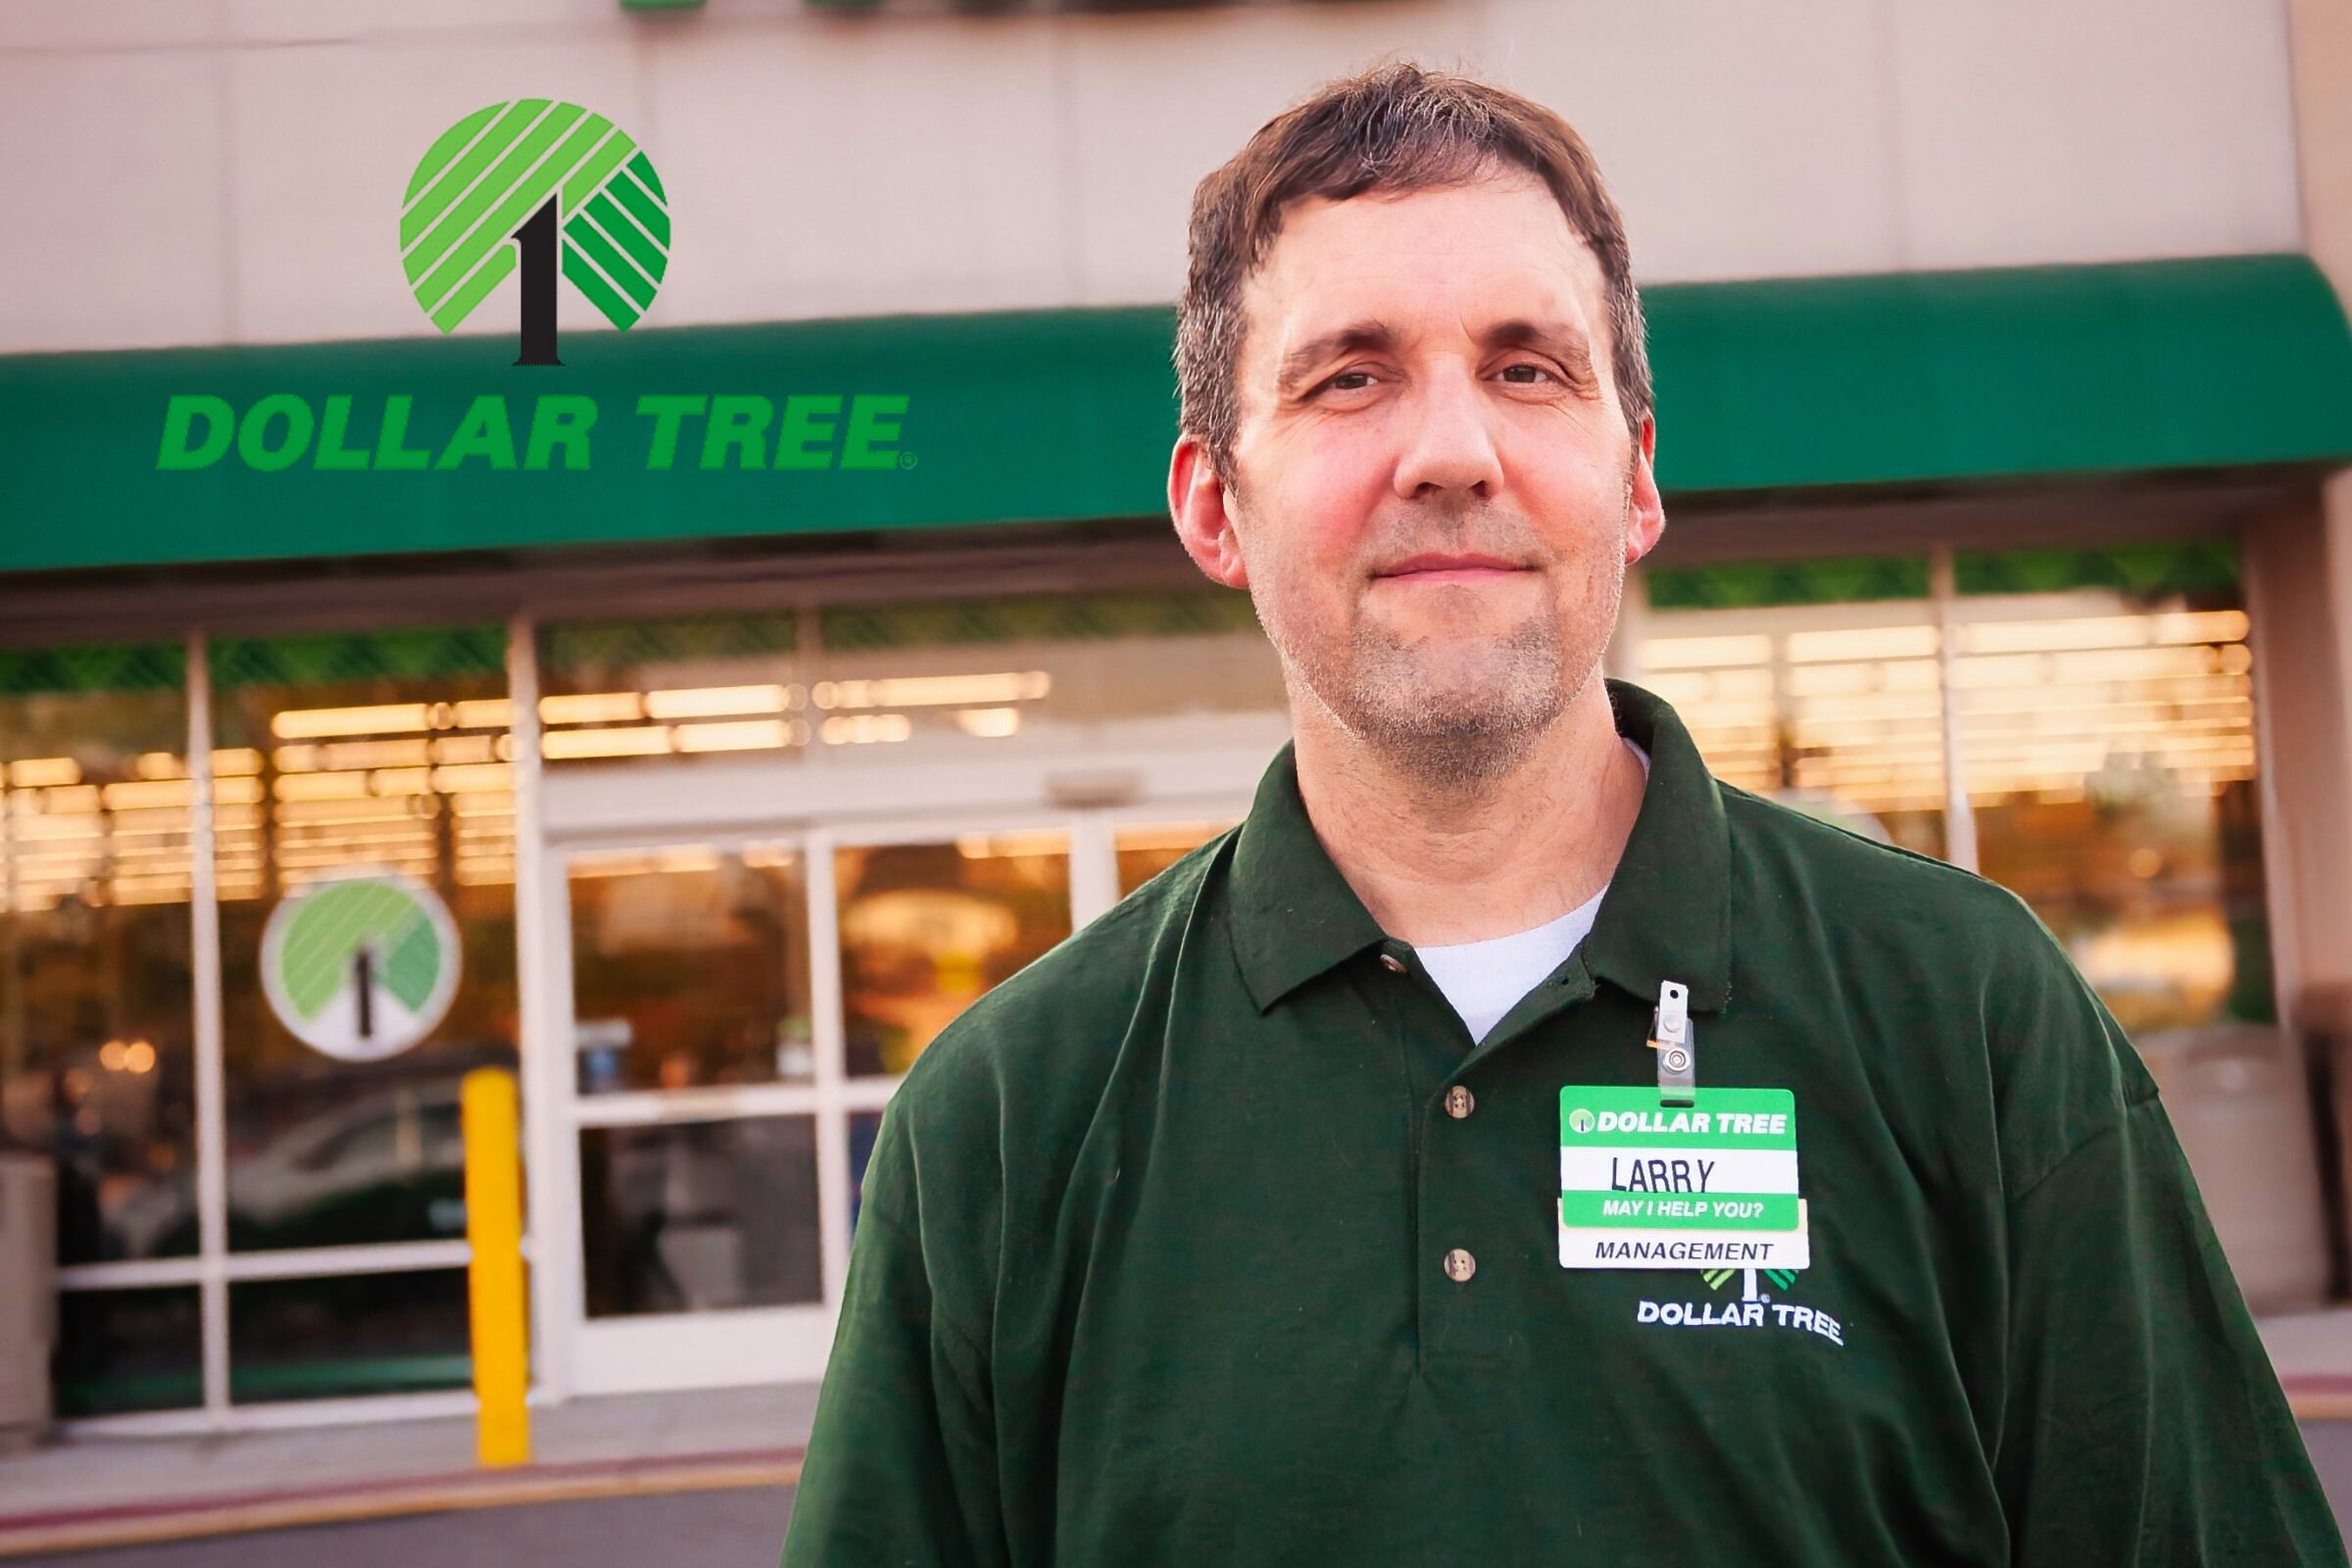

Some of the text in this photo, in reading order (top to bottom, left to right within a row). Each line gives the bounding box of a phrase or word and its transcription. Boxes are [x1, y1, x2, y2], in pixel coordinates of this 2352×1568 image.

[1597, 1110, 1788, 1135] DOLLAR TREE
[1610, 1156, 1716, 1194] LARRY
[1602, 1199, 1764, 1218] MAY I HELP YOU?
[1594, 1241, 1775, 1260] MANAGEMENT
[1637, 1299, 1844, 1347] DOLLAR TREE
